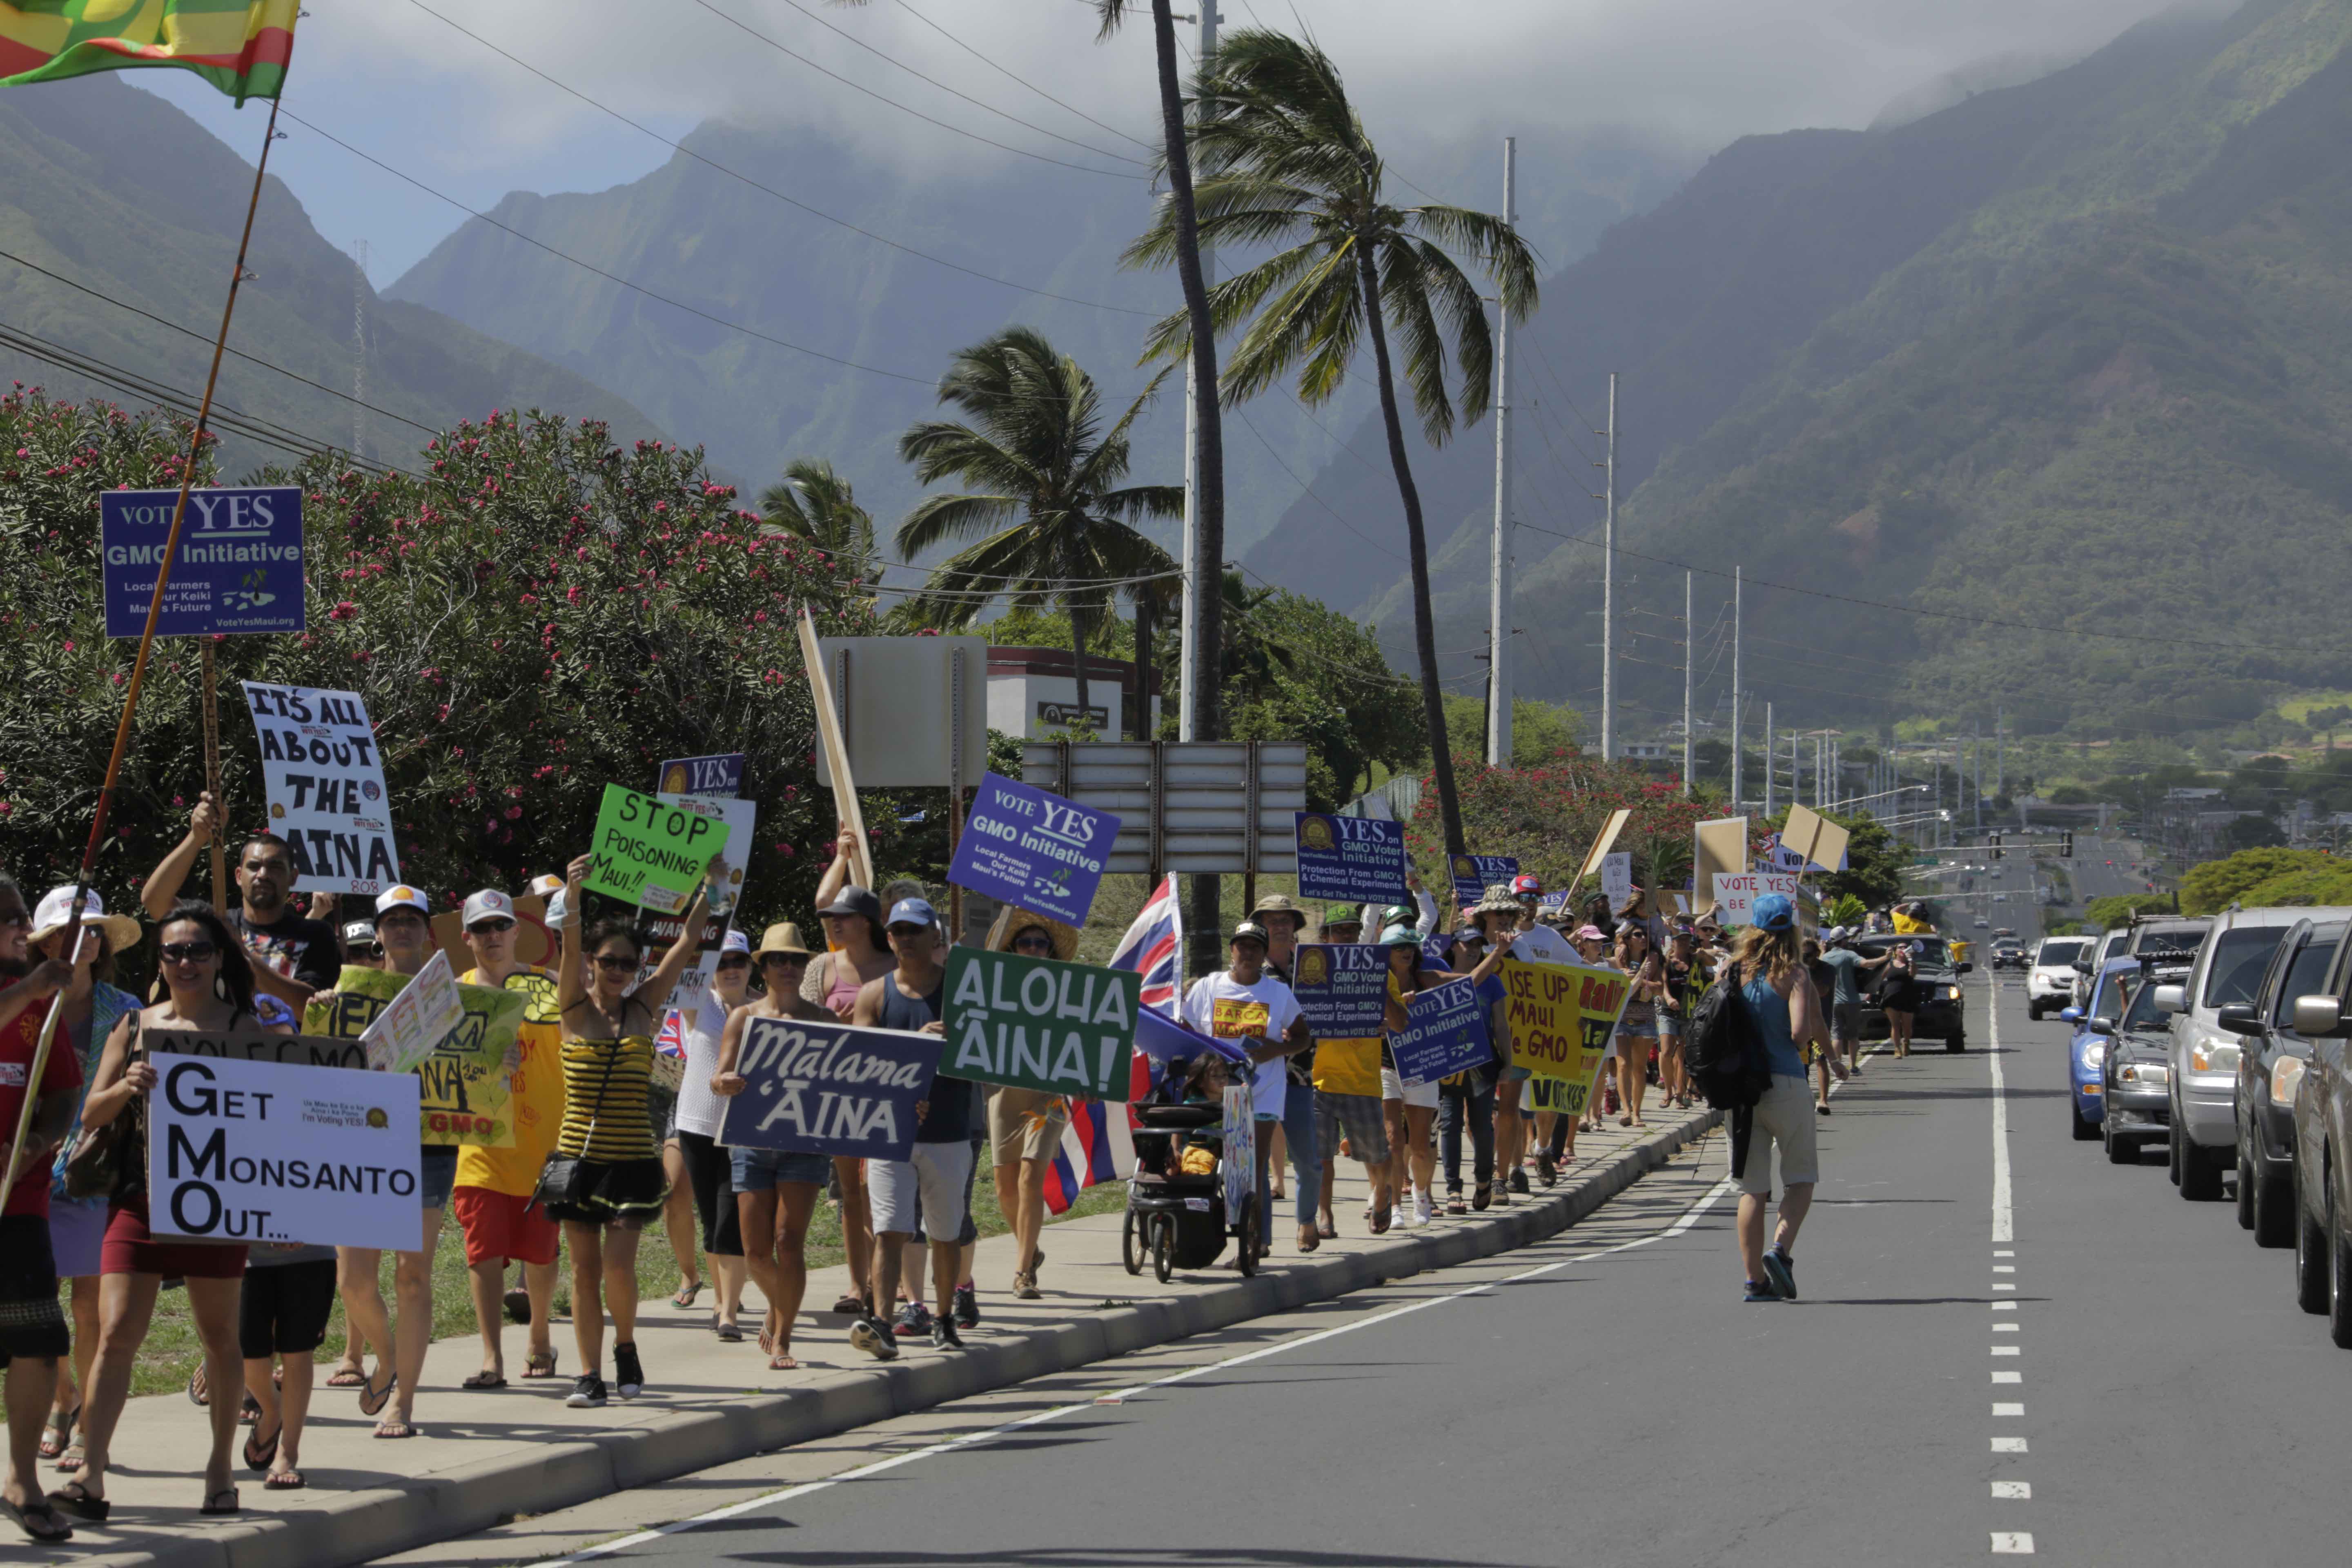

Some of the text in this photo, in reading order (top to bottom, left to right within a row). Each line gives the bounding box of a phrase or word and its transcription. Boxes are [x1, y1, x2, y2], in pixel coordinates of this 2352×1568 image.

[190, 494, 274, 530] YES
[183, 542, 300, 564] Initiative
[162, 591, 211, 601] ur Keiki
[130, 604, 212, 613] Maus Future
[216, 617, 295, 627] VoteYesMaui.org
[247, 686, 364, 726] IT'S ALL
[261, 729, 372, 767] ABOUT
[693, 759, 737, 789] YES on
[286, 773, 361, 815] THE
[619, 793, 709, 845] STOP
[995, 789, 1098, 842] VOTE YES
[1336, 817, 1385, 843] YES
[605, 828, 699, 878] POISONING
[973, 815, 1100, 873] GMO Initiative
[1342, 841, 1401, 856] GMO Voter
[975, 844, 1031, 871] Local Farmers
[1342, 851, 1399, 866] Initiative
[1474, 856, 1507, 872] YES
[591, 853, 646, 894] MAUI!!
[972, 862, 1026, 887] Maui's Future
[991, 860, 1029, 878] Our Keiki
[1301, 864, 1402, 881] Protection From GMO's
[350, 880, 379, 893] 808
[1302, 873, 1402, 890] & Chemical Experiments
[1719, 877, 1795, 893] VOTE YES
[1305, 889, 1321, 897] Let's
[1336, 891, 1348, 899] The
[1368, 893, 1386, 902] VOTE
[1542, 893, 1562, 904] YES
[1729, 899, 1746, 909] BE
[1023, 893, 1077, 920] VoteYesMaui.org
[654, 920, 718, 940] WARNG
[1332, 946, 1374, 970] YES
[1421, 940, 1441, 958] ES
[1334, 972, 1386, 983] GMO Voter
[952, 958, 1129, 1031] ALOHA
[1332, 984, 1382, 994] Initiative
[1432, 980, 1474, 1010] YES
[1543, 973, 1570, 1004] UP
[1216, 1007, 1265, 1020] BARCA
[1300, 1001, 1382, 1011] rotection From GMO's
[1337, 1012, 1381, 1023] Experiments
[1215, 1023, 1263, 1037] MAYOR
[1391, 1010, 1480, 1049] GMO Initiative
[1403, 1044, 1444, 1062] Local Farmers
[1528, 1029, 1568, 1063] GMO
[1428, 1057, 1448, 1068] Future
[165, 1062, 274, 1120] GET
[303, 1113, 363, 1127] I'm Voting YES!
[430, 1114, 494, 1134] GMO
[168, 1124, 416, 1196] MONSANTO
